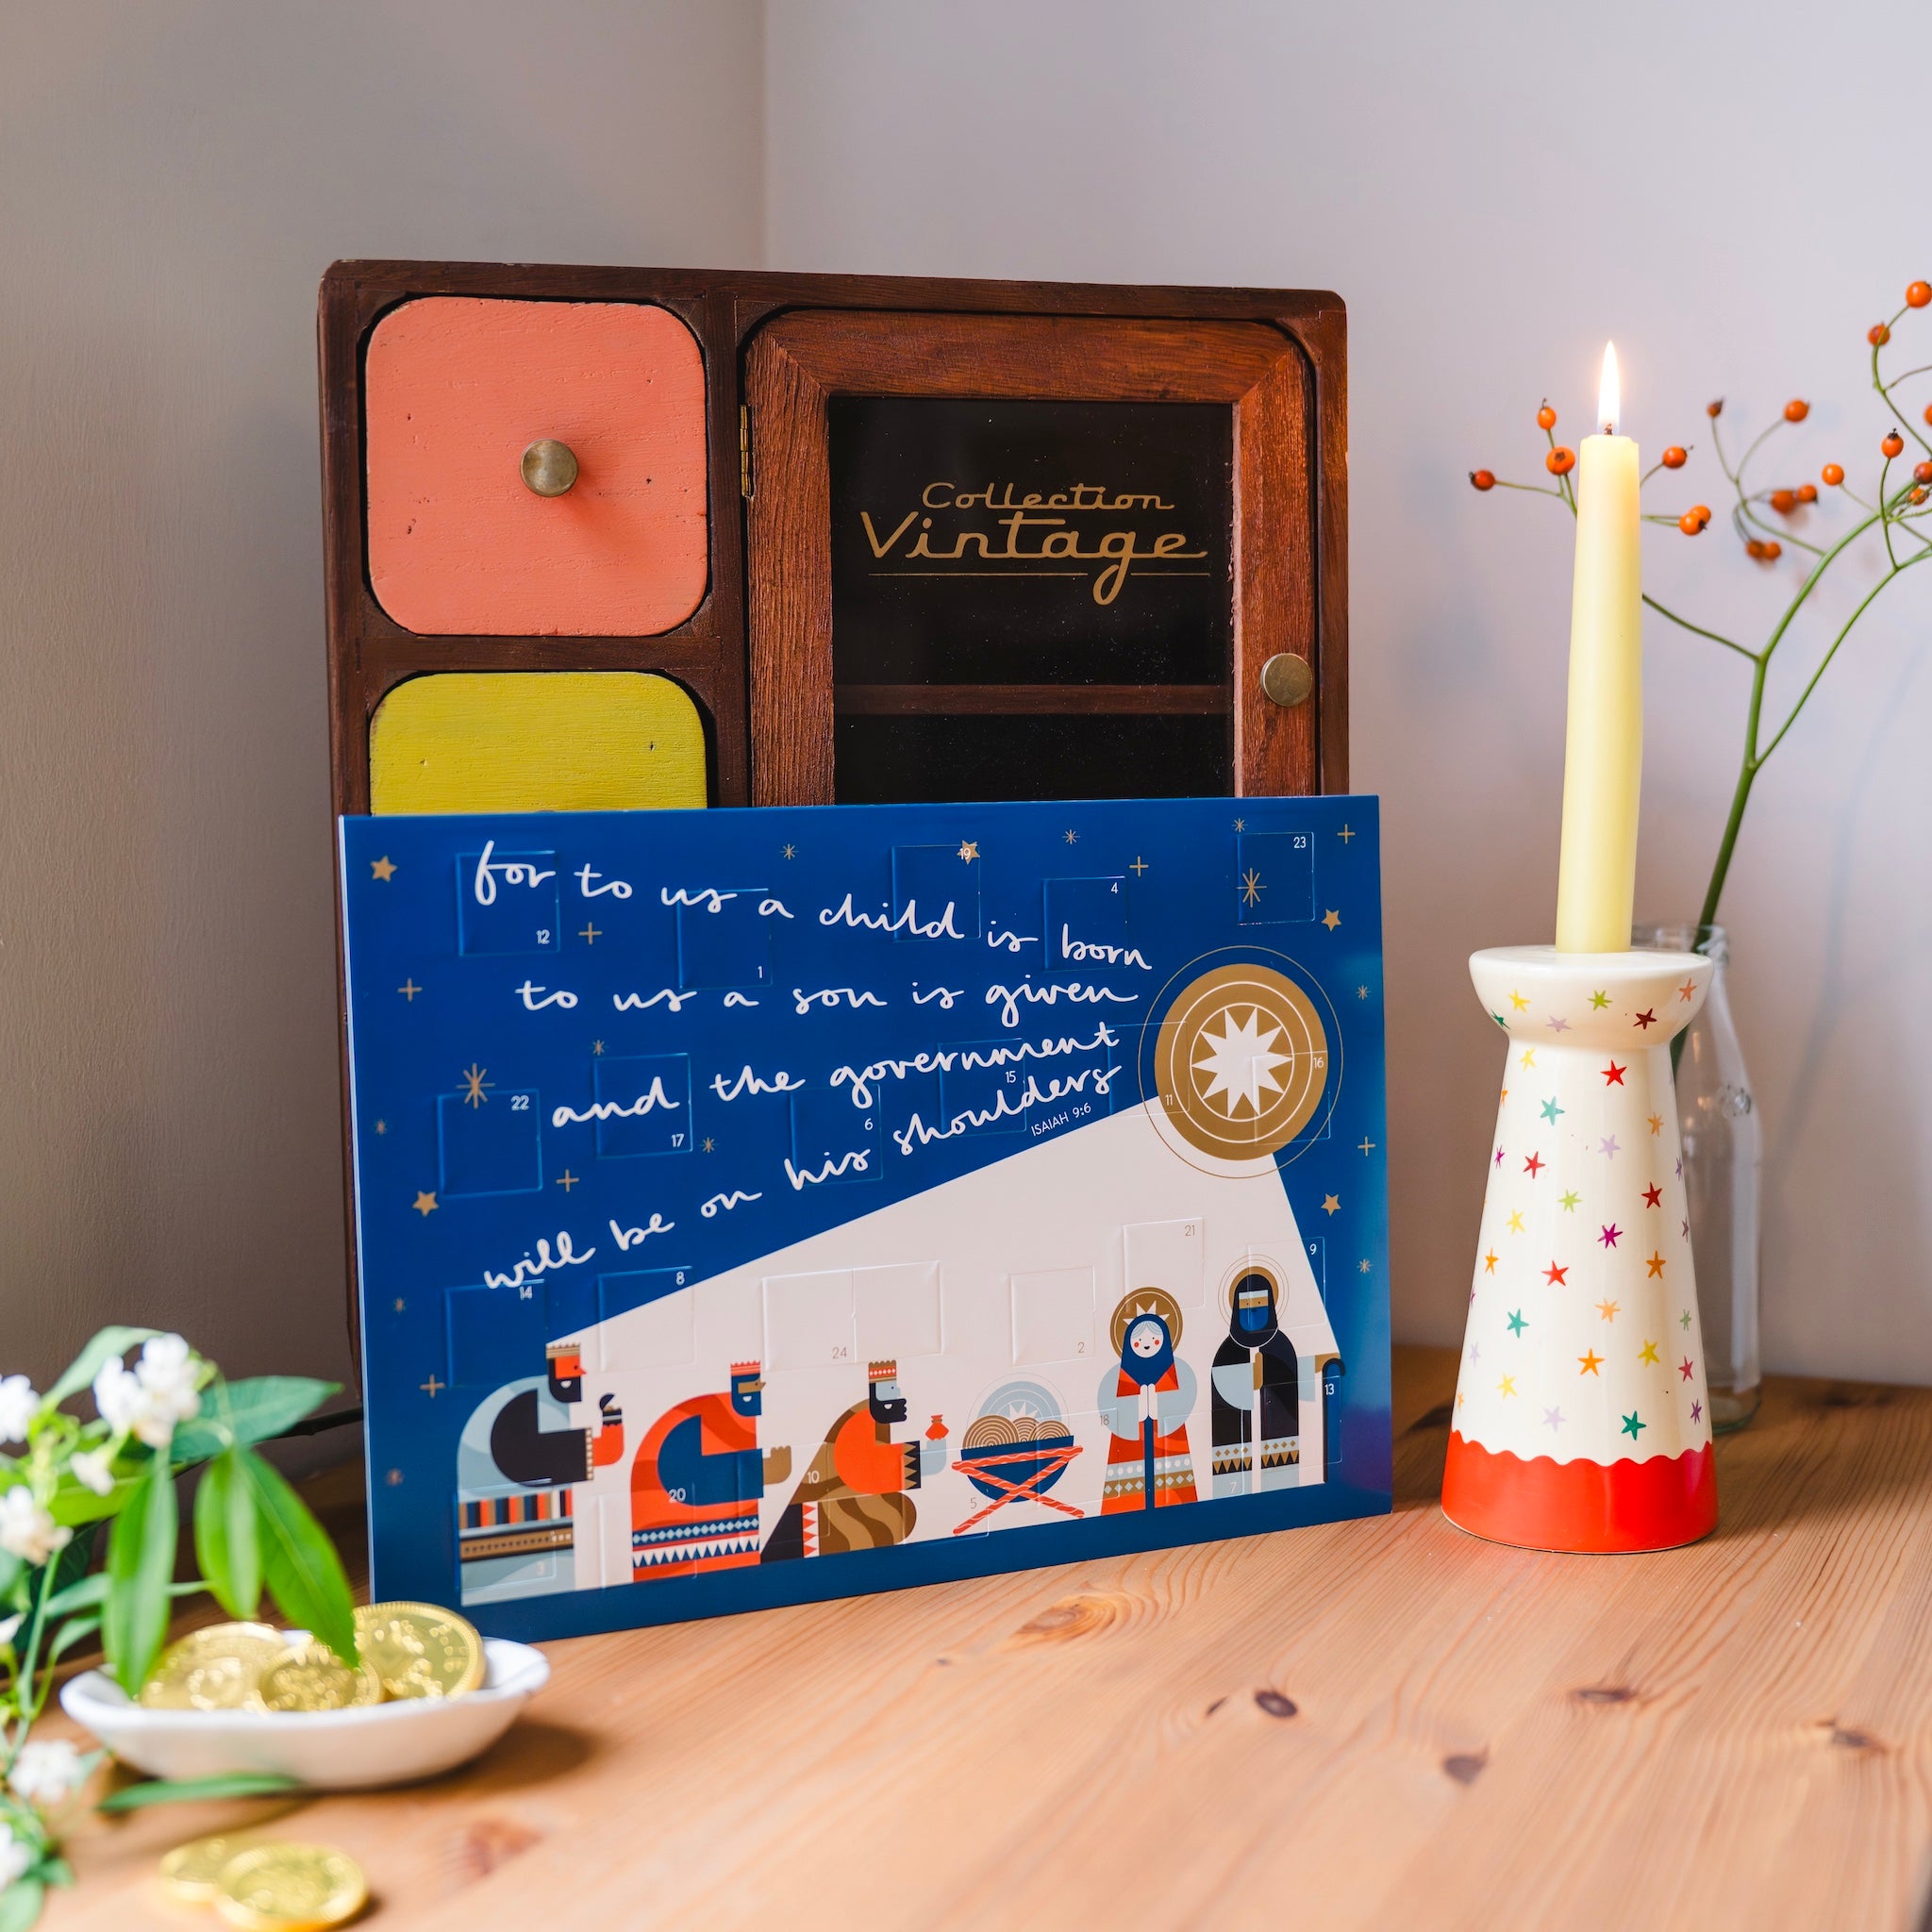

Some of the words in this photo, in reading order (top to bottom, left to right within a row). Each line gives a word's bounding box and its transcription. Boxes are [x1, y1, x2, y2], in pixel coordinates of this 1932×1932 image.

[922, 482, 1175, 510] Collection
[859, 510, 1208, 606] Vintage
[1292, 837, 1307, 849] 23
[959, 848, 972, 860] 19
[1110, 883, 1119, 894] 4
[475, 841, 556, 906] for
[575, 863, 632, 899] to
[661, 887, 737, 913] us
[758, 898, 793, 918] a
[819, 893, 964, 940] child
[987, 921, 1038, 953] is
[1061, 924, 1152, 970] born
[537, 930, 549, 944] 12
[758, 966, 763, 979] 1
[515, 980, 578, 1011] to
[613, 989, 697, 1012] us
[724, 991, 759, 1008] a
[793, 987, 887, 1014] son
[913, 982, 964, 1009] is
[985, 974, 1139, 1026] given
[1312, 1058, 1324, 1069] 16
[552, 1076, 679, 1127] and
[709, 1065, 806, 1102] the
[830, 1023, 1120, 1109] government
[1005, 1072, 1016, 1084] 15
[511, 1096, 529, 1110] 22
[1165, 1094, 1174, 1107] 11
[864, 1119, 874, 1132] 6
[1031, 1111, 1069, 1137] ISAIAH
[1072, 1103, 1092, 1119] 9:6
[671, 1134, 684, 1148] 17
[484, 1231, 595, 1289] will
[609, 1213, 675, 1250] be
[701, 1191, 762, 1218] on
[784, 1149, 871, 1191] his
[893, 1066, 1122, 1155] shoulders
[1184, 1224, 1196, 1237] 21
[1309, 1243, 1318, 1256] 9
[675, 1272, 685, 1286] 8
[519, 1287, 532, 1299] 14
[833, 1347, 847, 1358] 24
[1076, 1342, 1085, 1355] 2
[1324, 1384, 1335, 1396] 13
[1099, 1414, 1109, 1426] 18
[808, 1470, 818, 1483] 10
[1229, 1480, 1238, 1494] 7
[669, 1488, 686, 1502] 20
[970, 1496, 977, 1509] 5
